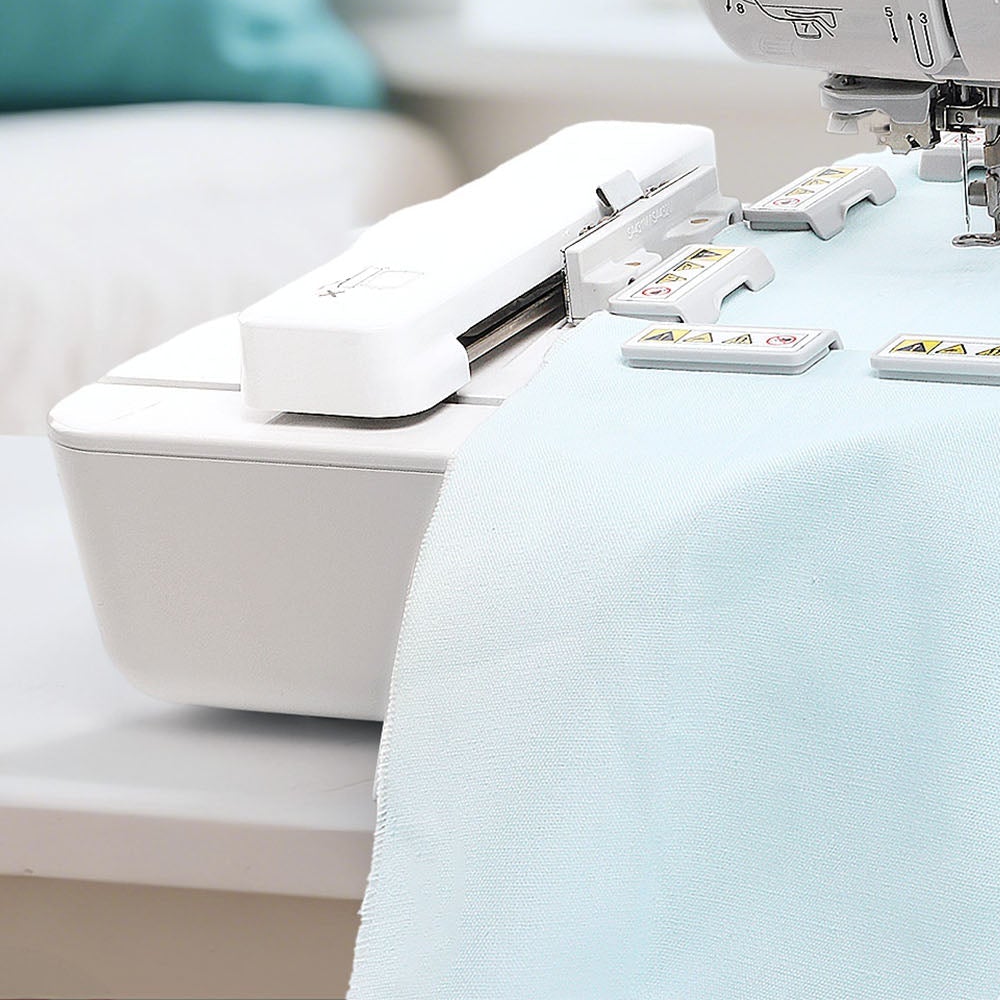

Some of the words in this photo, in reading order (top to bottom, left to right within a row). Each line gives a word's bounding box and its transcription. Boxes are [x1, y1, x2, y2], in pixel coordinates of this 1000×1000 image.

[736, 3, 745, 14] 8
[884, 6, 893, 18] 5
[919, 12, 928, 24] 3
[801, 23, 810, 34] 7
[955, 111, 965, 124] 6
